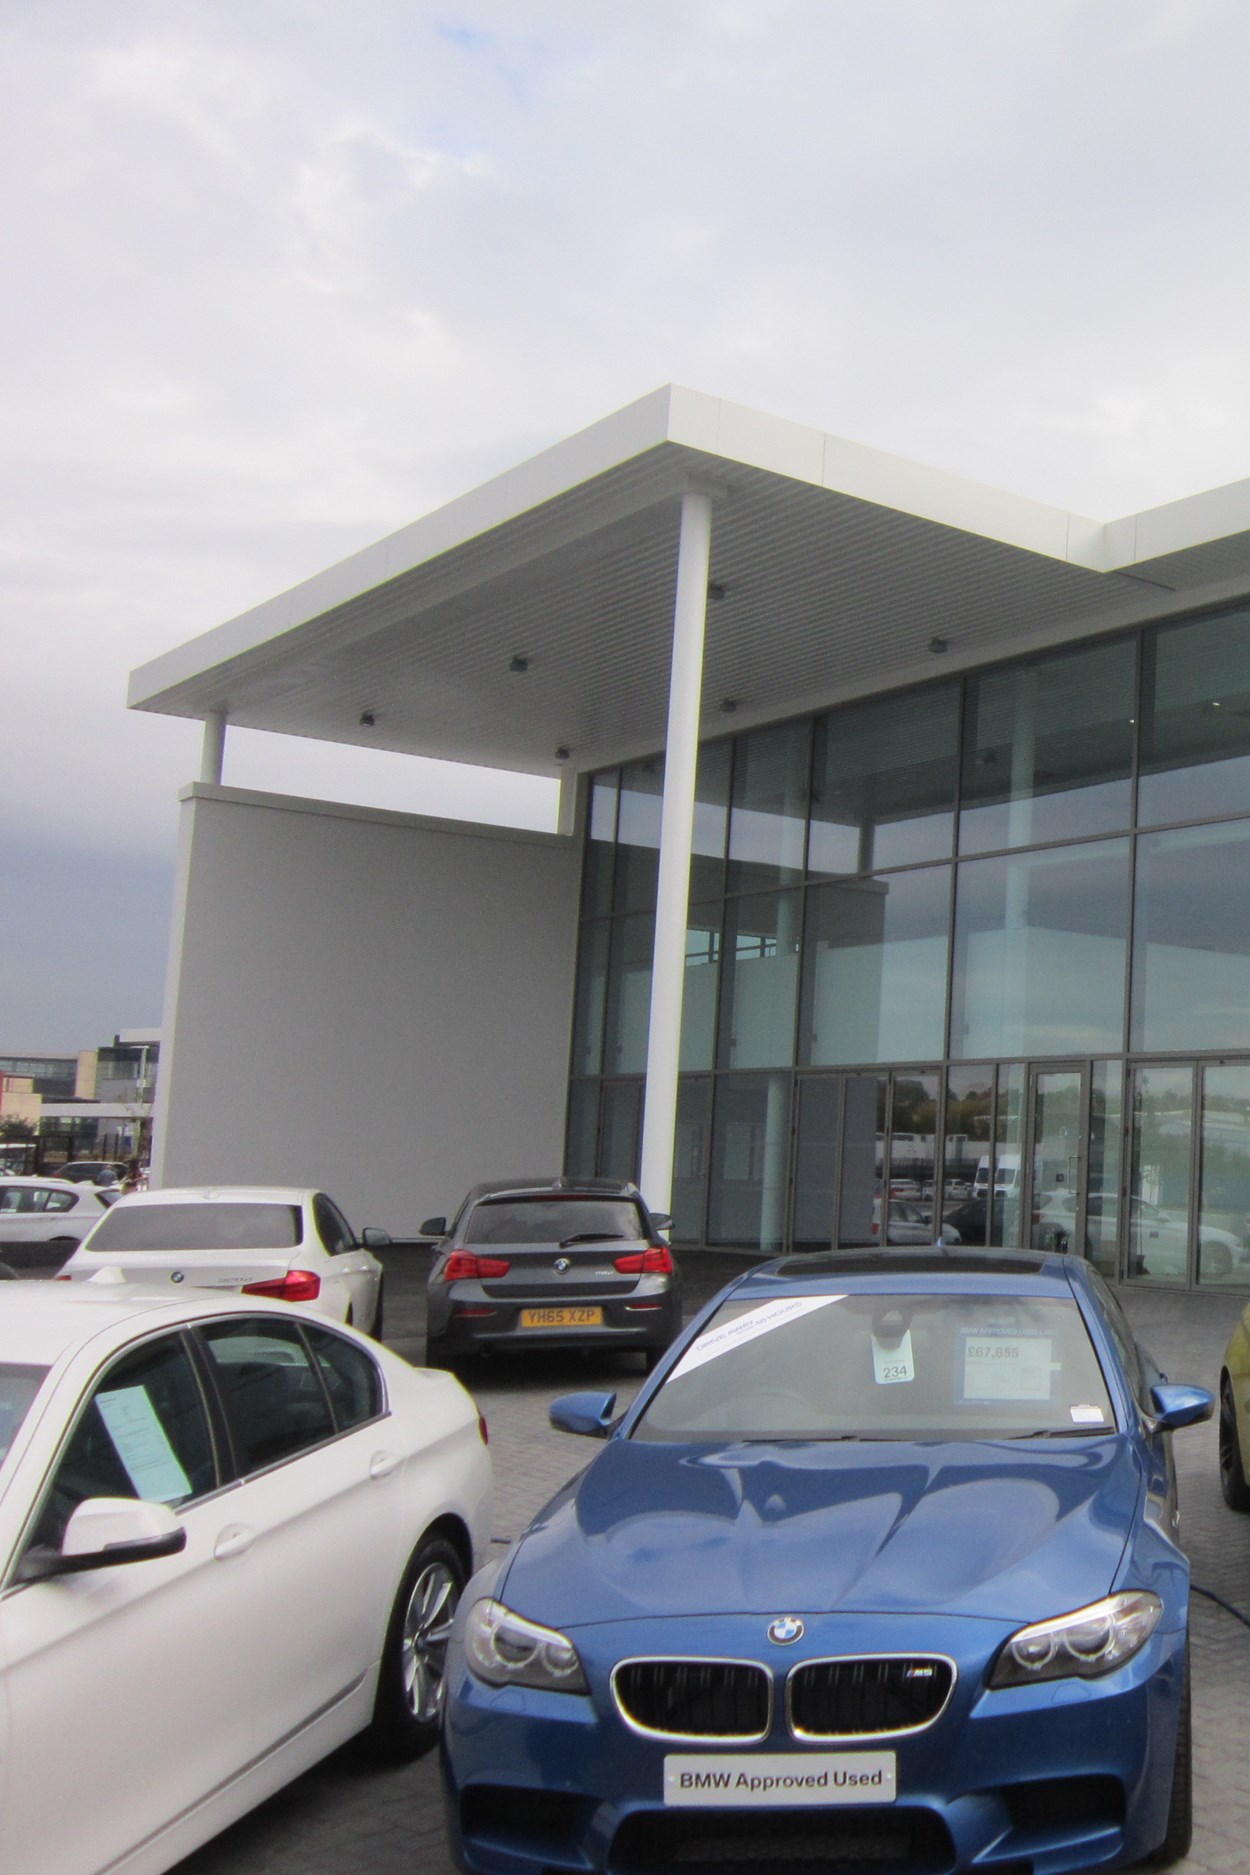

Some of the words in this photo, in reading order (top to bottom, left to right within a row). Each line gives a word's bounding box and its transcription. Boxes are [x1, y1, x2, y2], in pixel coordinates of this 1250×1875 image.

[528, 1310, 564, 1324] YH65
[568, 1309, 595, 1323] XZP
[883, 1365, 908, 1379] 234
[680, 1772, 731, 1789] BMW
[735, 1771, 828, 1792] Approved
[833, 1769, 883, 1786] Used
